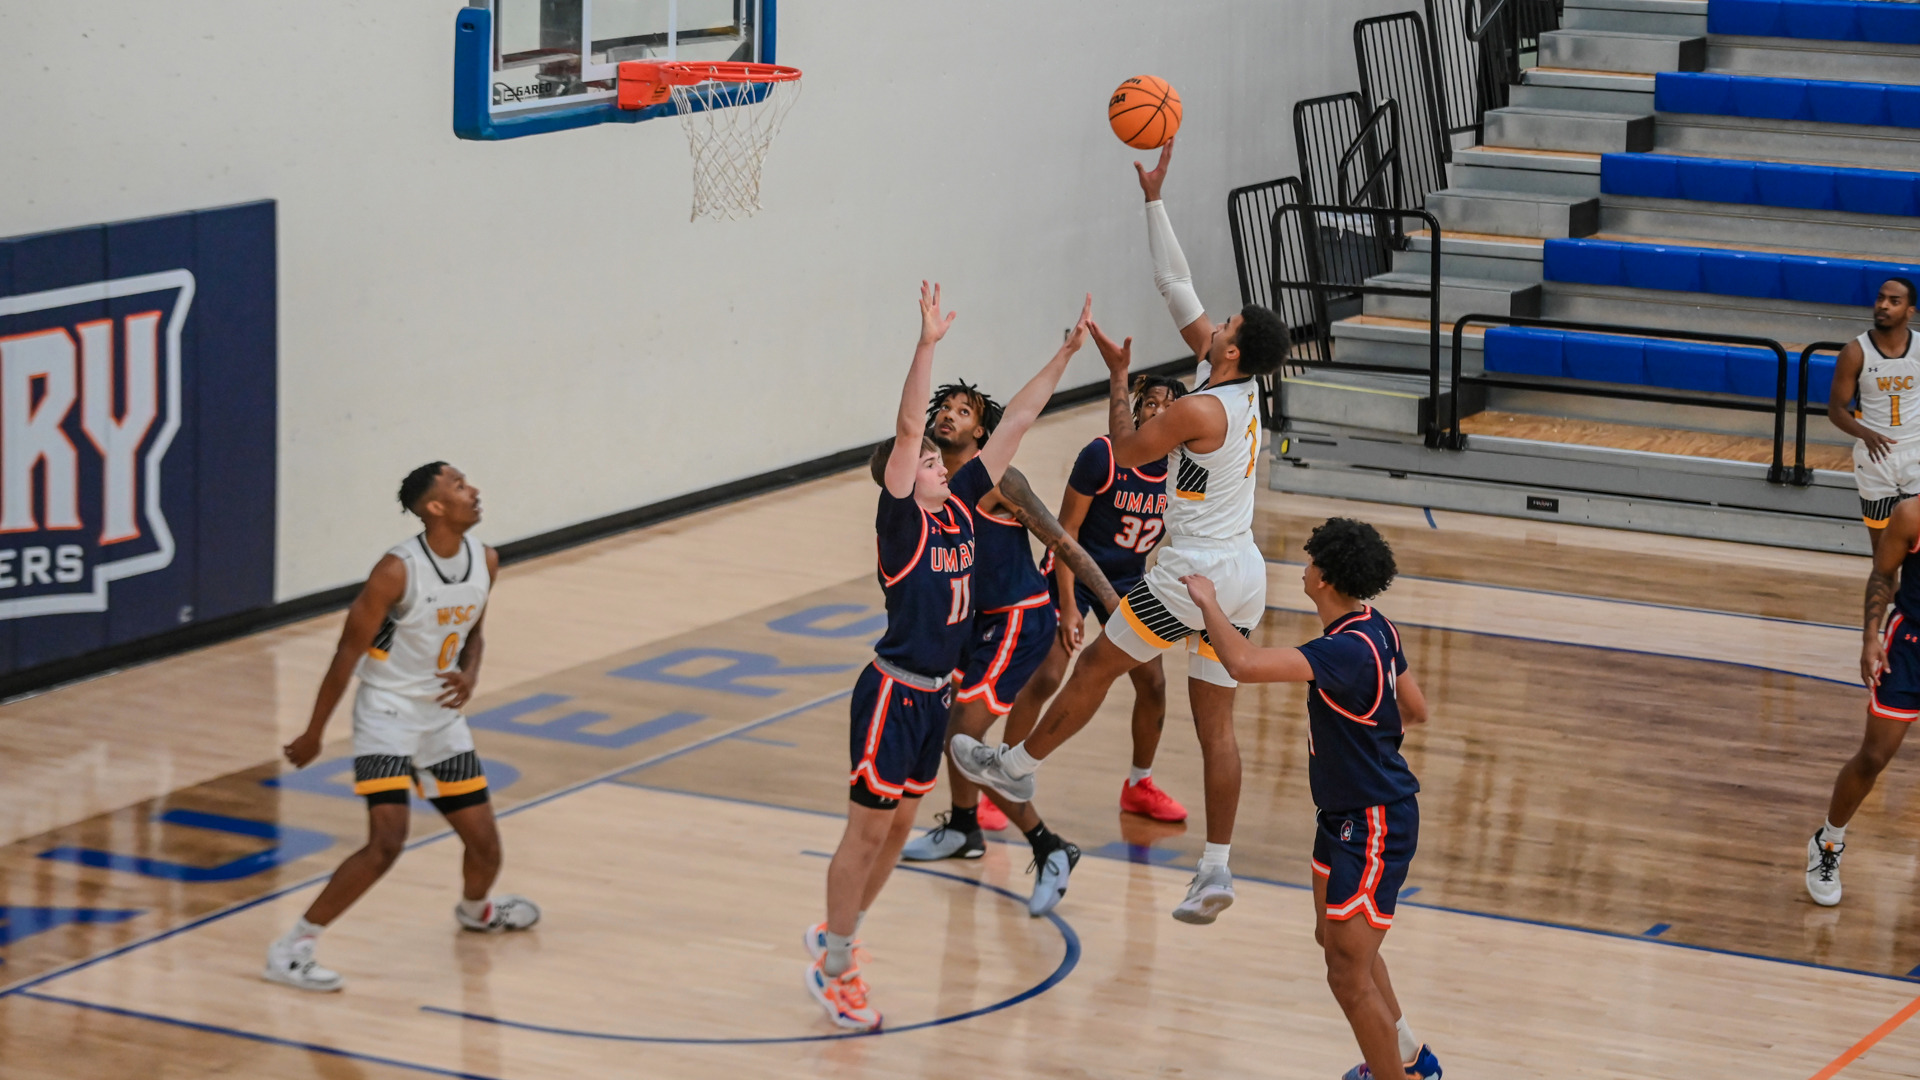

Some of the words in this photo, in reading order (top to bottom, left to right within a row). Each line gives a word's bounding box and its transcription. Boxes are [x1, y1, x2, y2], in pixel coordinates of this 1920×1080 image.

[1876, 376, 1914, 391] WSC
[0, 311, 162, 545] RY
[1888, 395, 1902, 427] 1
[1114, 490, 1167, 514] UMAR
[1114, 515, 1164, 553] 32
[437, 605, 476, 626] WSC
[946, 573, 971, 626] 11
[437, 632, 460, 670] 0
